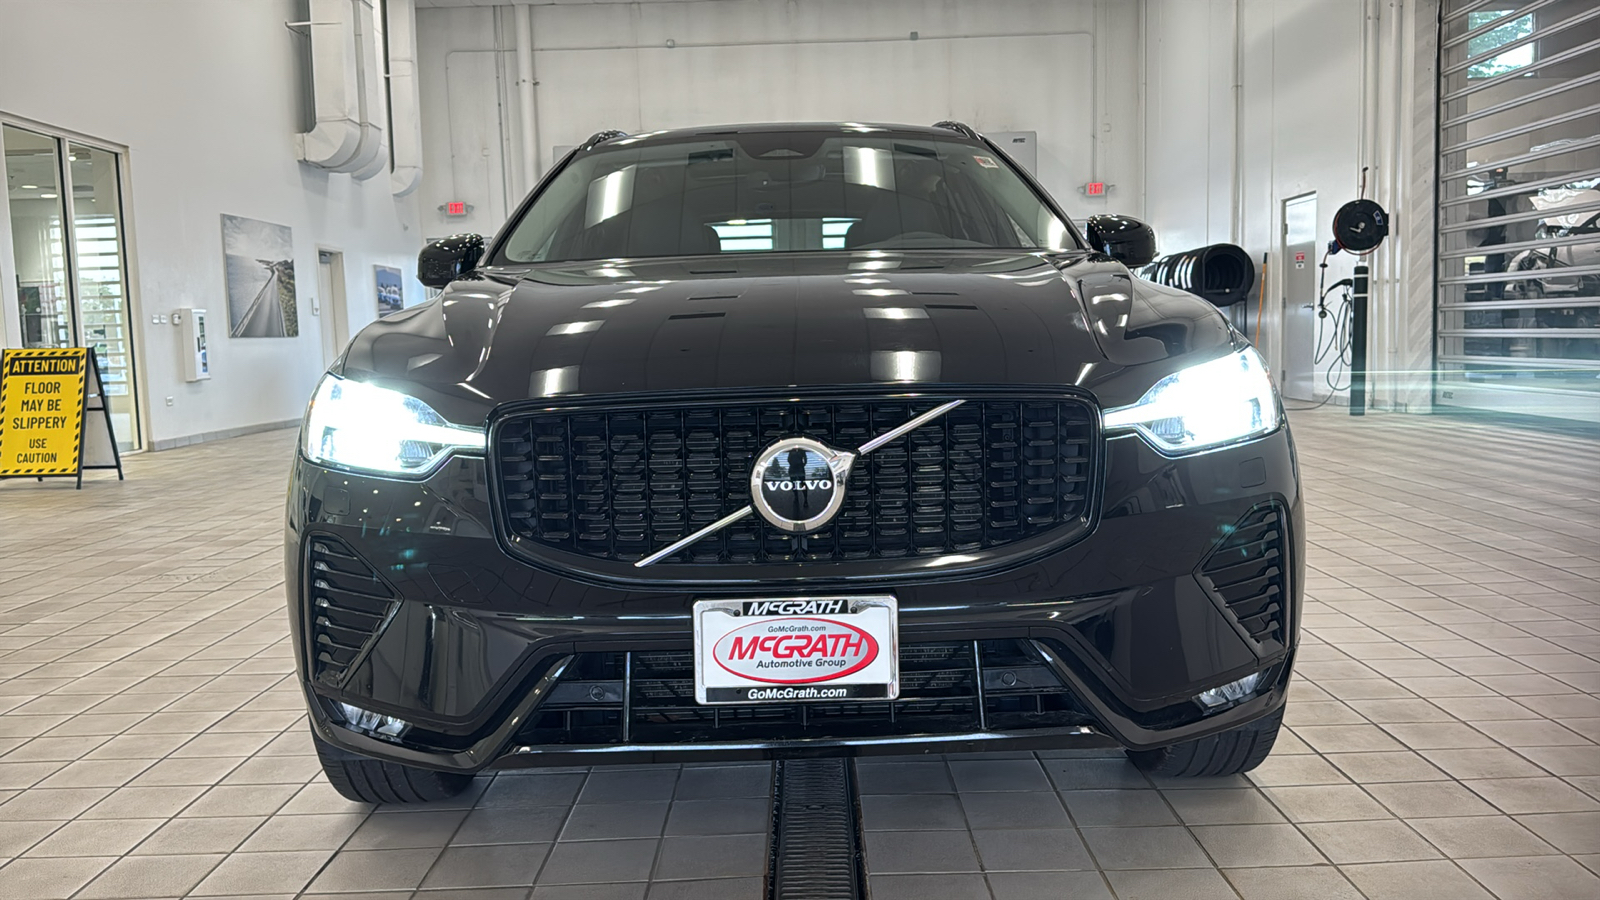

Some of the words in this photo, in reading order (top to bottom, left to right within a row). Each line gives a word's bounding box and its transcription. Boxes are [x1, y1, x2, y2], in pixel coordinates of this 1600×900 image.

[12, 359, 76, 373] ATTENTION
[24, 381, 61, 394] FLOOR
[21, 399, 44, 412] MAY
[47, 399, 62, 411] BE
[12, 416, 67, 429] SLIPPERY
[29, 438, 47, 449] USE
[16, 452, 57, 463] CAUTION
[764, 480, 832, 491] VOLVO
[767, 625, 826, 633] GoMcGrath.com
[756, 659, 813, 669] Automotive
[815, 658, 847, 668] Group
[747, 687, 847, 700] GoMcGrath.com
